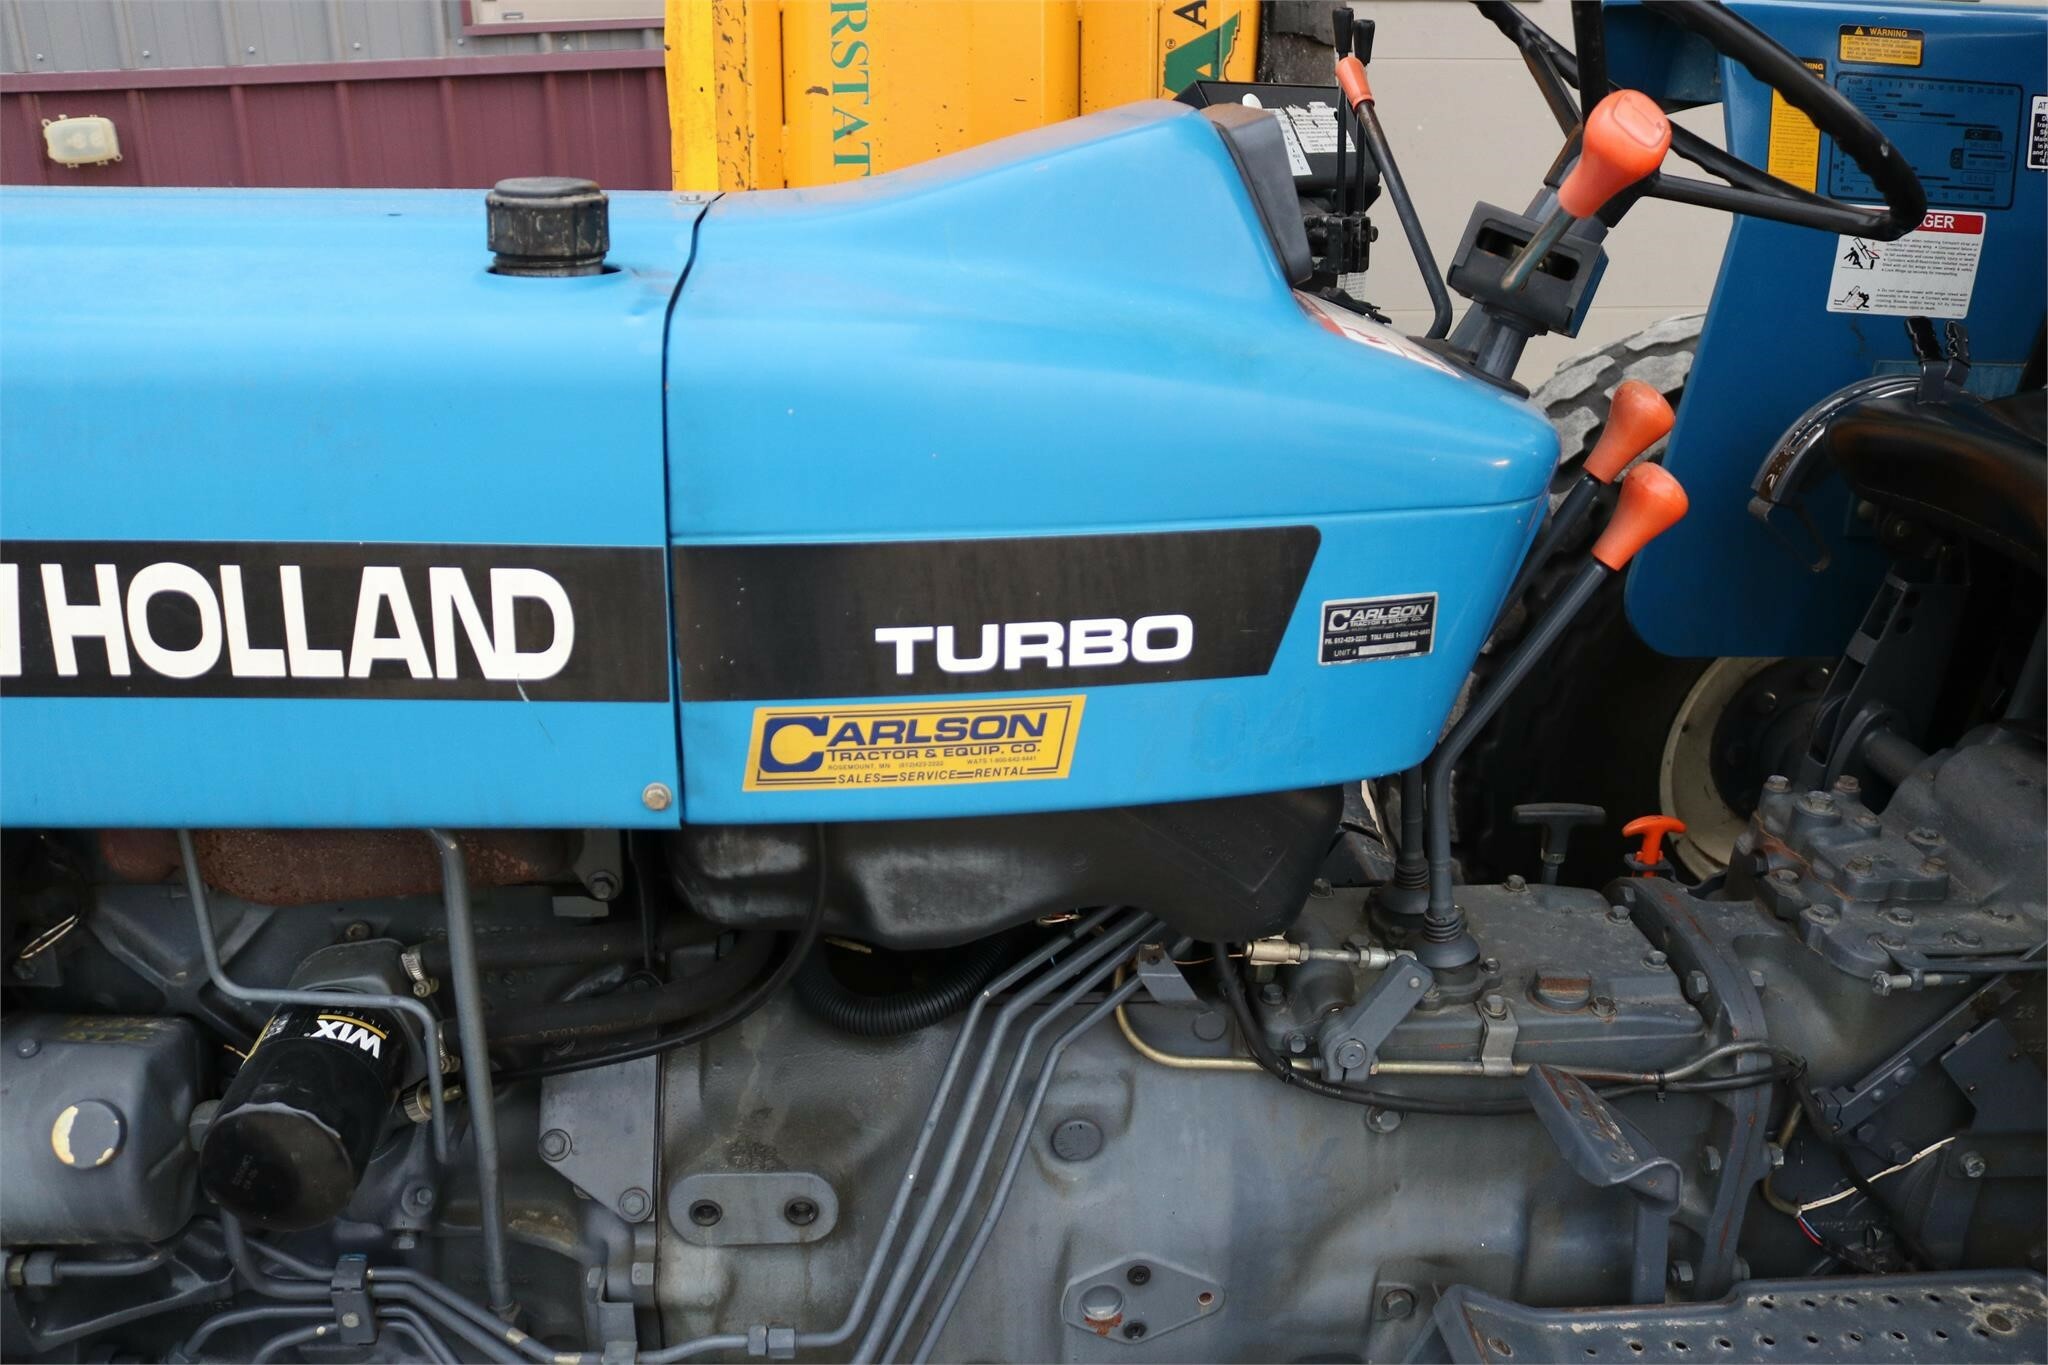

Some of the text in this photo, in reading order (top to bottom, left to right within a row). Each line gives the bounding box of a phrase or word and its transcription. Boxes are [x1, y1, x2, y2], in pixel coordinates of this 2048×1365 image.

[1870, 28, 1908, 38] WARNING
[41, 562, 575, 681] HOLLAND
[1328, 604, 1429, 632] CARLSON
[875, 614, 1194, 675] TURBO
[759, 712, 1048, 774] CARLSON
[829, 742, 1041, 763] TRACTOR & EQUIP. CO.
[837, 766, 1027, 785] SALES SERVICE RENTAL
[310, 1020, 381, 1060] WIX
